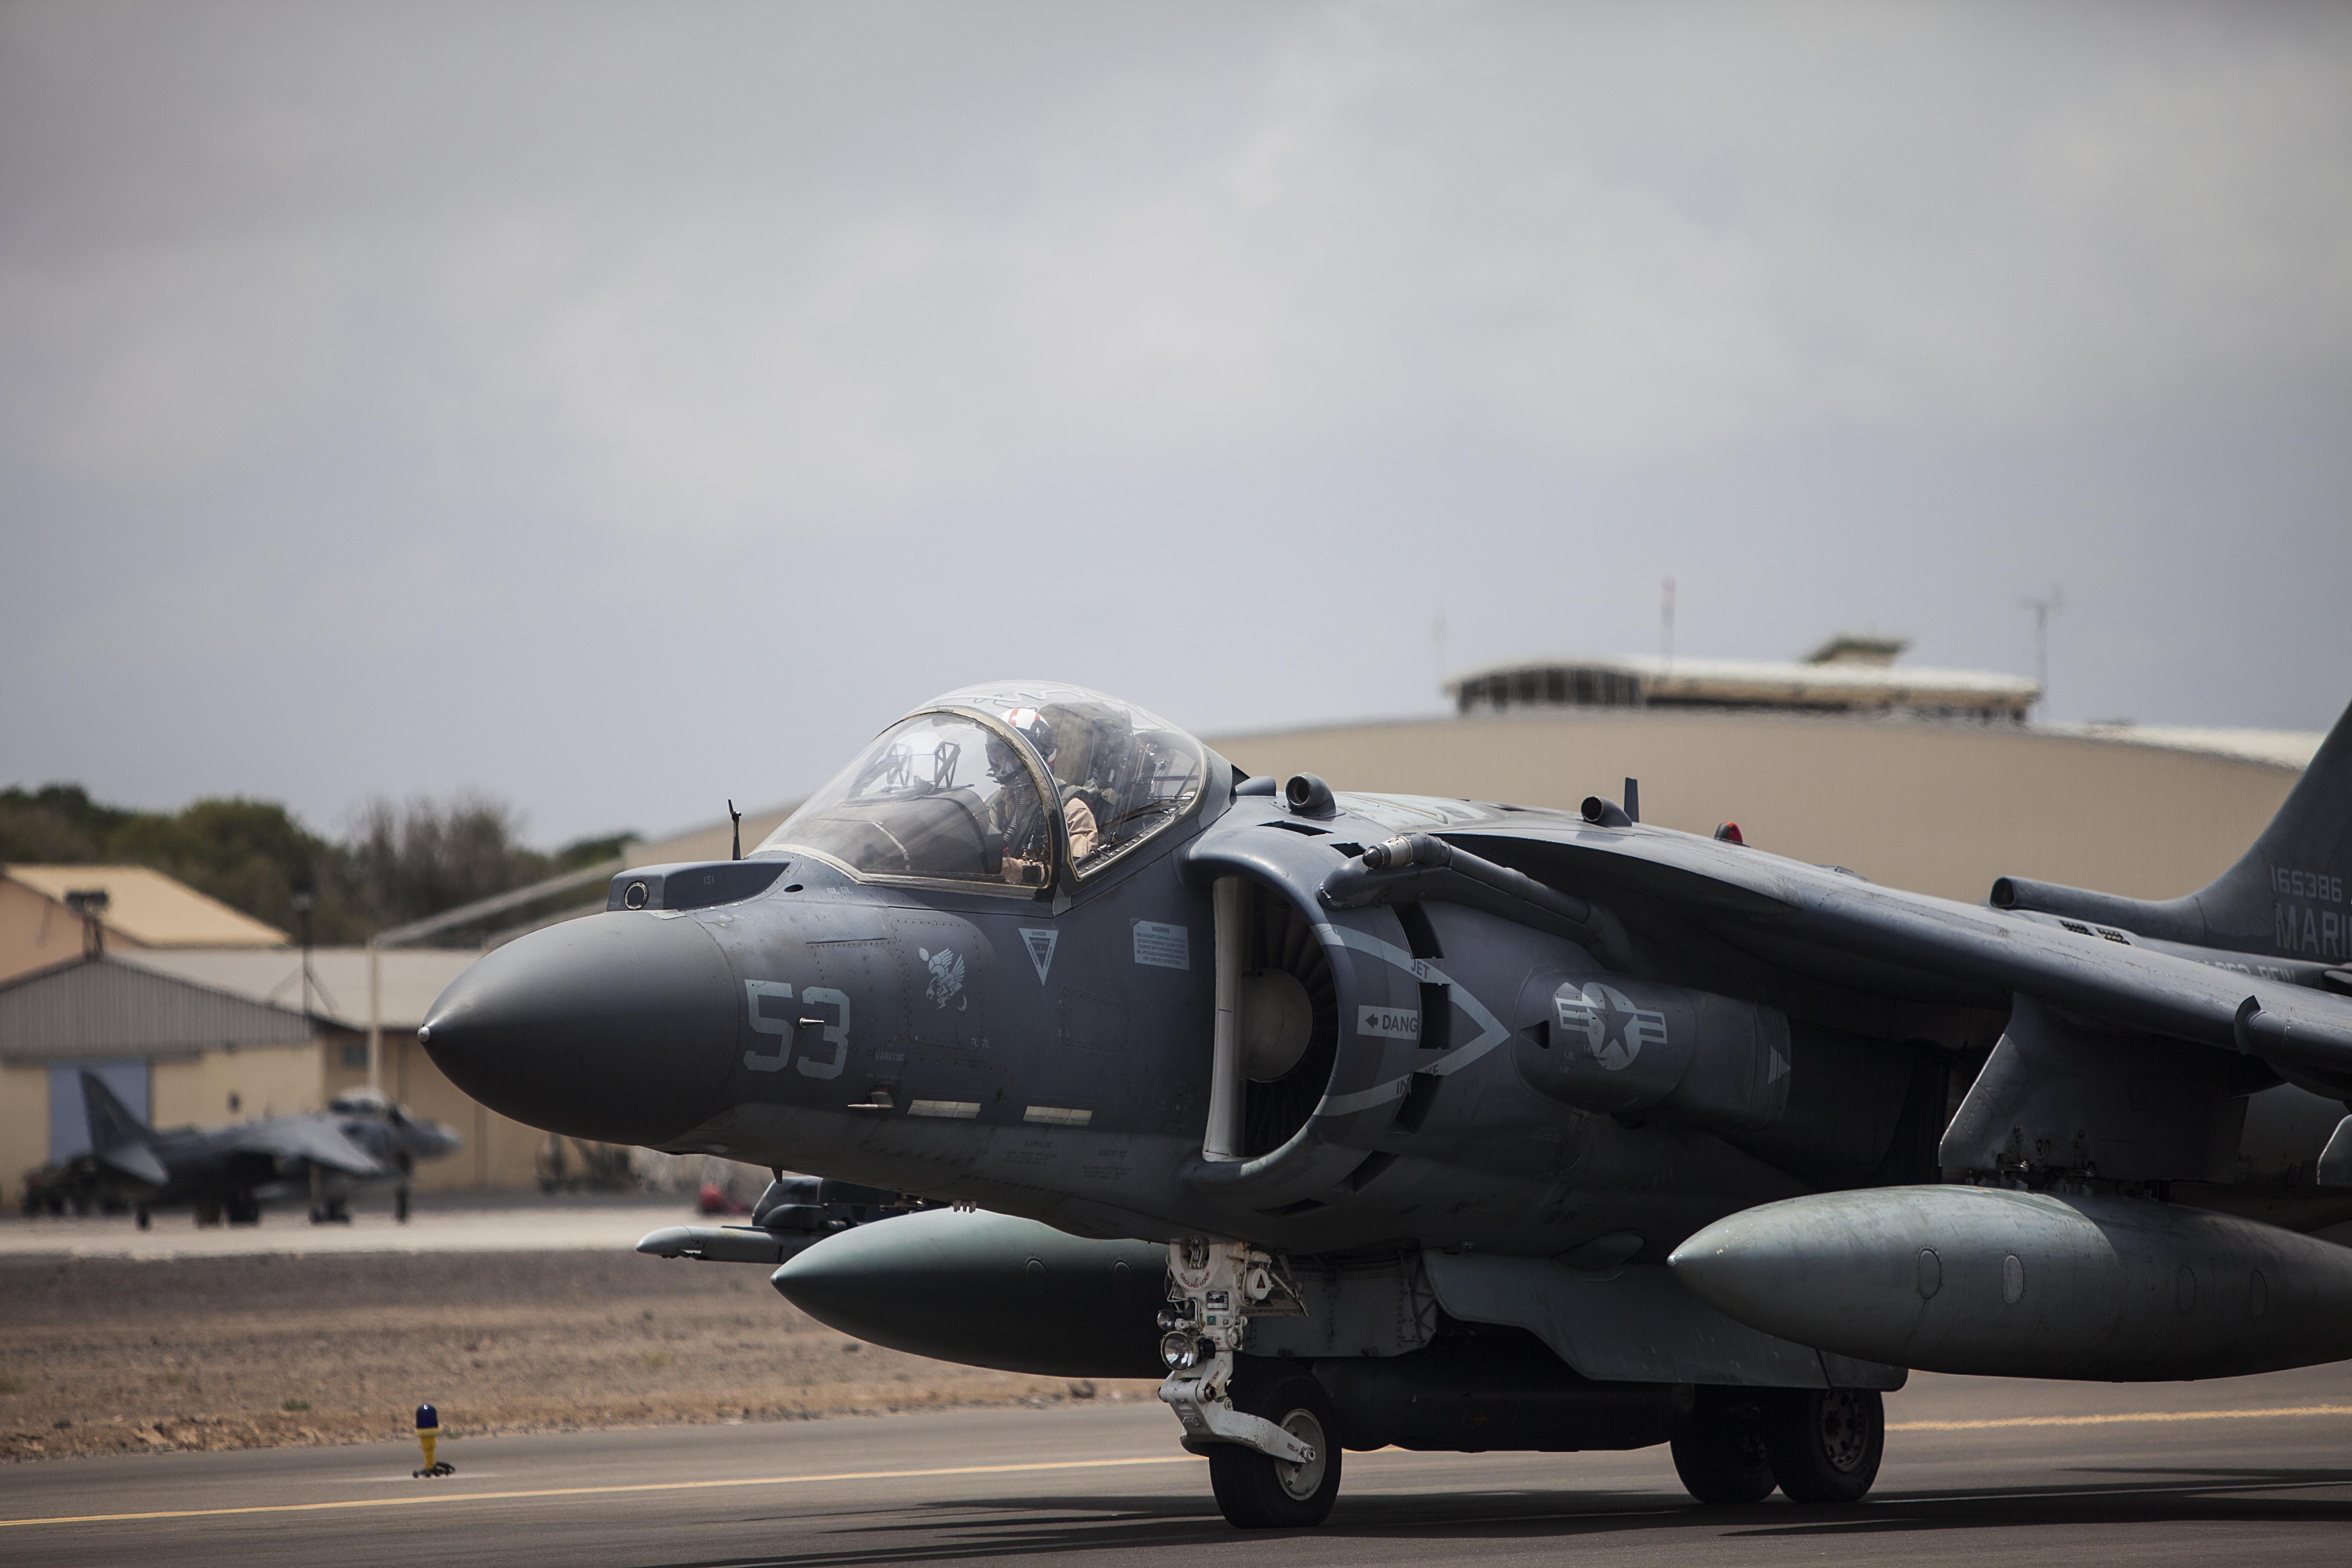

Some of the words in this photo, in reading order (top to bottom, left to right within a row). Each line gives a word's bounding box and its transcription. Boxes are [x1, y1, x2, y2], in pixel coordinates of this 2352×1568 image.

[704, 875, 714, 885] 151
[2269, 865, 2342, 903] 165386
[2275, 903, 2352, 959] MARI
[1028, 944, 1039, 966] DANGER
[1411, 959, 1429, 979] JET
[743, 979, 850, 1080] 53
[875, 1052, 904, 1062] WARNING
[1024, 1139, 1054, 1149] WARNING
[1098, 1149, 1128, 1158] WARNING
[1180, 1273, 1199, 1288] GROUND
[1200, 1271, 1210, 1286] LOCK
